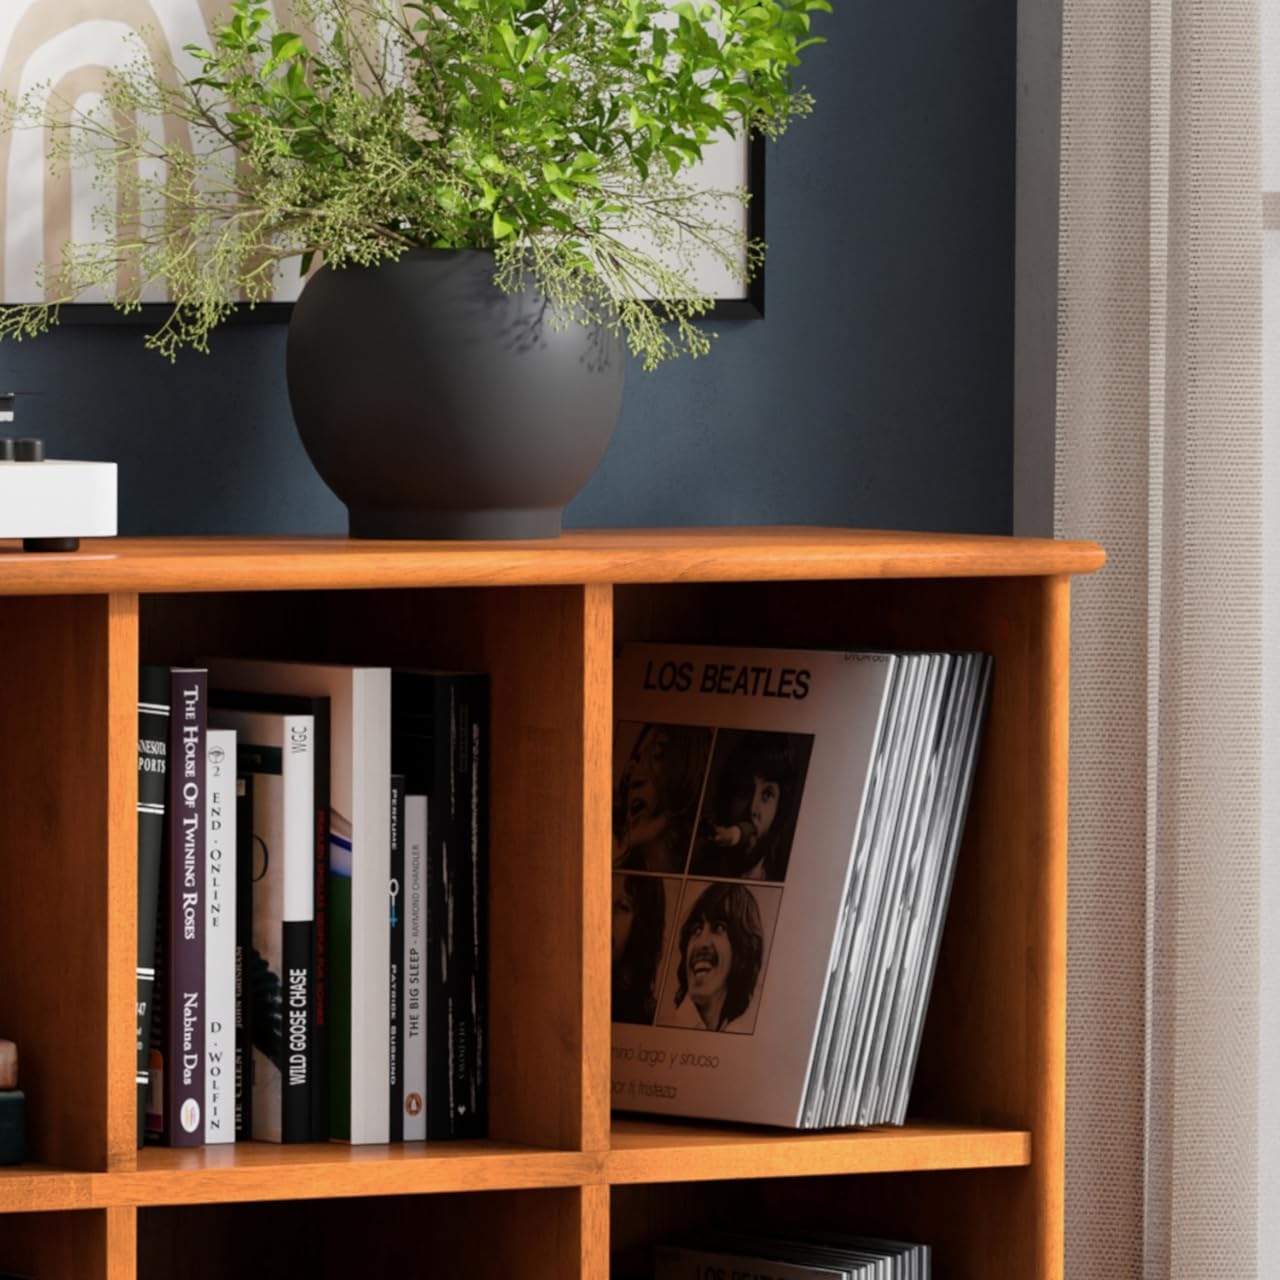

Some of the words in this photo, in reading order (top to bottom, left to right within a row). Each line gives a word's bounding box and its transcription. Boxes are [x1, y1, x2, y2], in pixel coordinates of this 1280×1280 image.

[643, 660, 694, 693] LOS
[699, 663, 811, 700] BEATLES
[183, 684, 199, 720] THE
[183, 726, 199, 778] HOUSE
[291, 726, 308, 755] WGC
[139, 756, 166, 774] PORTS
[183, 782, 199, 808] OF
[211, 791, 222, 831] END
[183, 812, 199, 888] TWINING
[411, 844, 420, 891] CHANDLER
[210, 849, 222, 928] ONLINE
[183, 892, 199, 940] ROSES
[411, 893, 420, 938] RAYMOND
[409, 948, 419, 984] SLEEP
[289, 968, 307, 1007] CHASE
[409, 988, 419, 1010] BIG
[183, 992, 199, 1051] Nabina
[289, 1009, 307, 1052] GOOSE
[409, 1014, 419, 1038] THE
[183, 1054, 199, 1085] Das
[289, 1054, 307, 1086] WILD
[208, 1051, 223, 1130] WOLFIN
